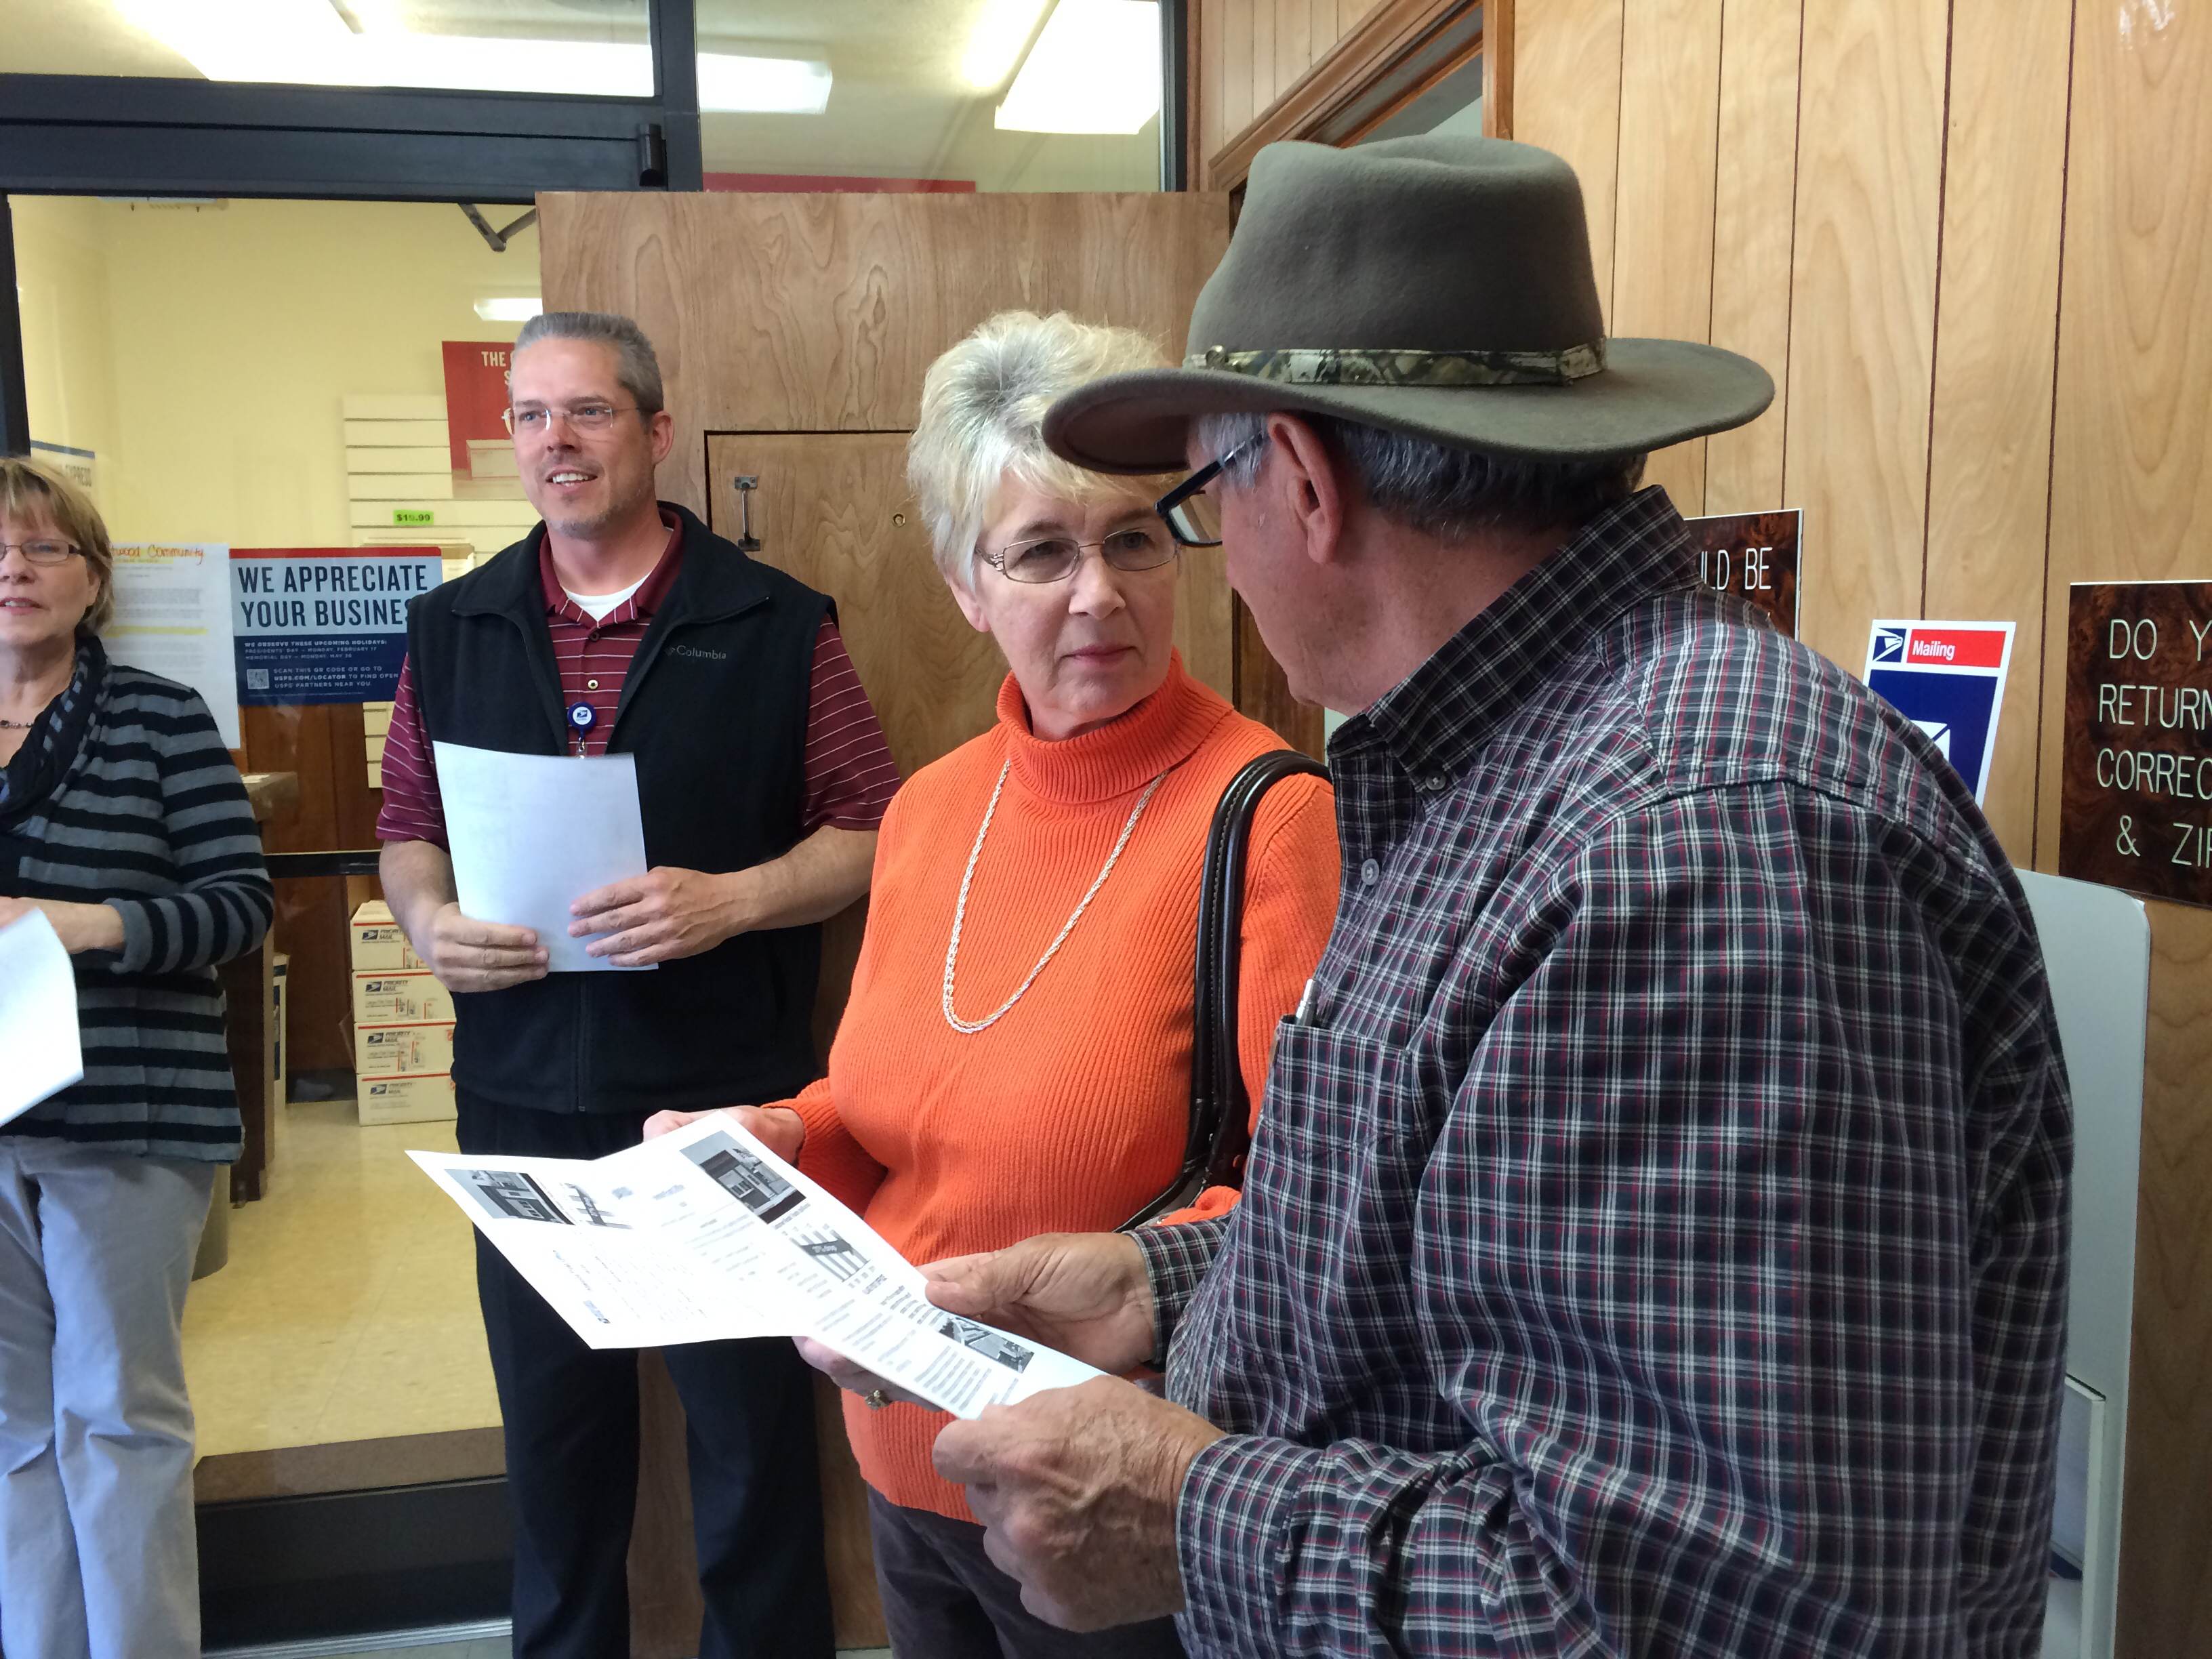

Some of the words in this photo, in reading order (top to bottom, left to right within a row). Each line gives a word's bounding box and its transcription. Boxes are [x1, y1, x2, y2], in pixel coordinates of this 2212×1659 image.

[481, 350, 506, 367] THE
[148, 544, 203, 566] Community
[1744, 547, 1773, 590] BE
[238, 567, 274, 593] WE
[283, 565, 428, 592] APPRECIATE
[241, 600, 306, 628] YOUR
[676, 644, 726, 659] Columbia
[1912, 640, 1956, 661] Mailing
[2109, 618, 2157, 660] DO
[2097, 747, 2212, 800] CORREC
[2116, 815, 2141, 857] &
